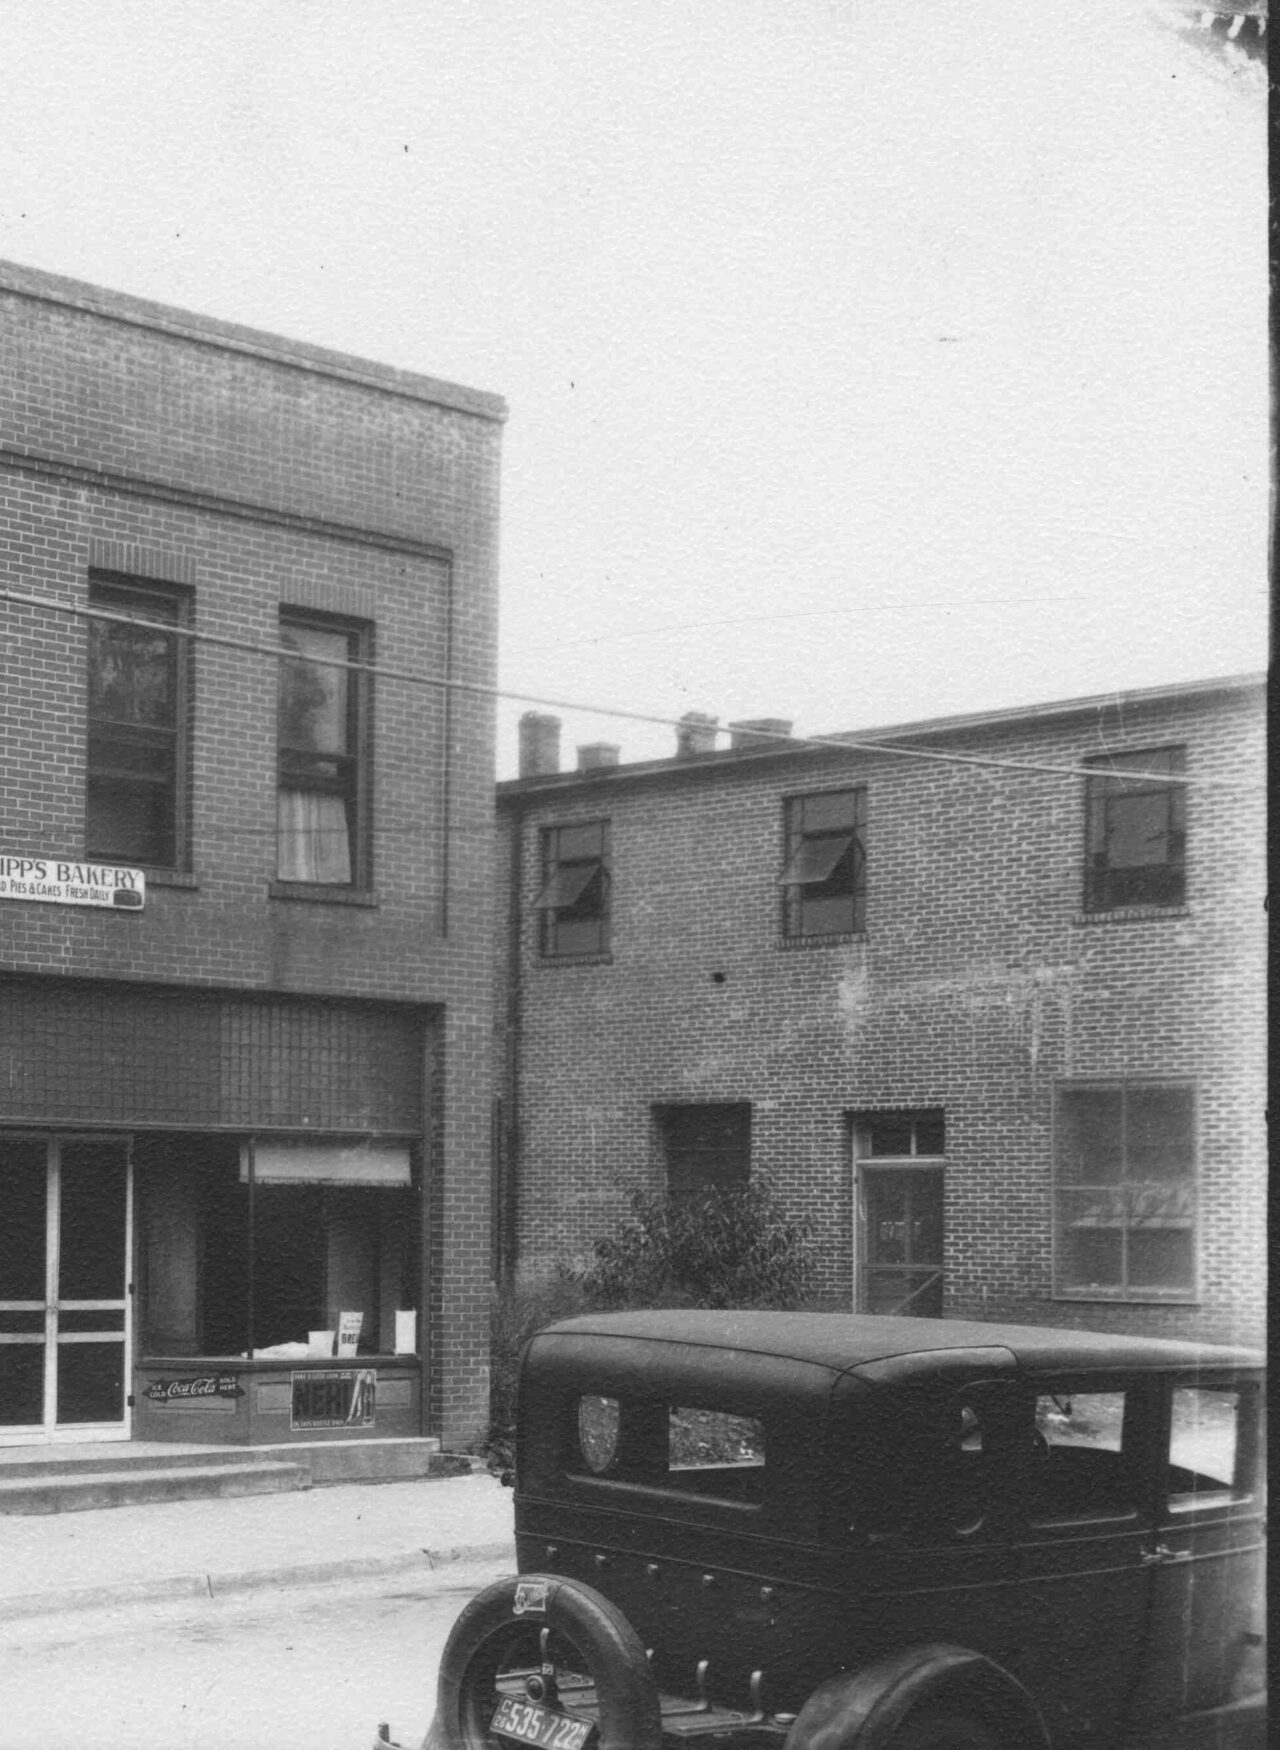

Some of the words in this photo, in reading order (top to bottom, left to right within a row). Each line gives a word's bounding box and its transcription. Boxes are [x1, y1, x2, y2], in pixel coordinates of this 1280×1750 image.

[57, 863, 140, 889] BAKERY
[10, 879, 27, 894] PIES
[66, 884, 89, 899] FRESH
[89, 887, 110, 901] DAILY
[167, 1377, 216, 1397] Coca-Cola
[219, 1376, 237, 1384] SOLD
[149, 1391, 166, 1399] COLD
[501, 1699, 512, 1713] C
